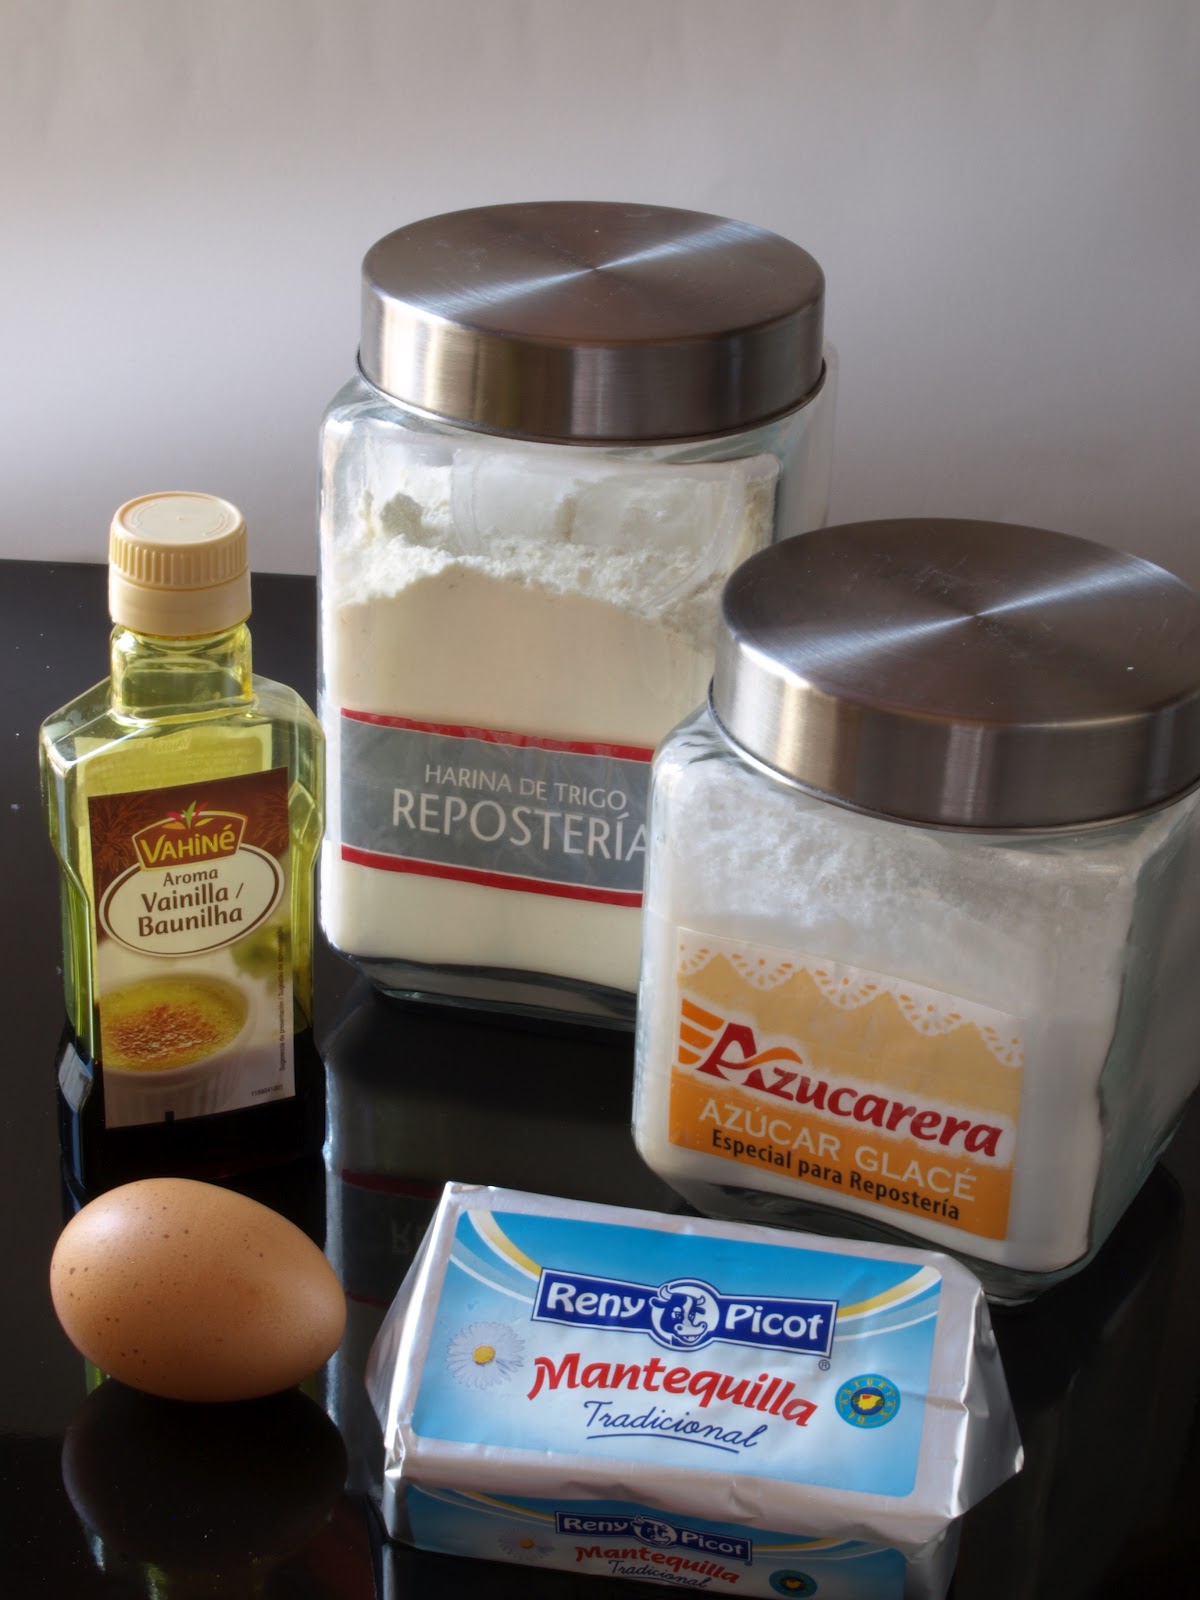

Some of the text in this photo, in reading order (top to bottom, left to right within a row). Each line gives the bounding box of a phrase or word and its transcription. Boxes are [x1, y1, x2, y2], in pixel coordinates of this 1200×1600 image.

[425, 764, 627, 811] HARINA DE TRIGO
[392, 788, 648, 862] REPOSTERÍA
[141, 882, 245, 913] Vainilla /
[163, 868, 219, 887] Aroma
[138, 904, 243, 937] Baunilha
[695, 1022, 1003, 1157] Azucarera
[700, 1099, 977, 1201] AZÚCAR GLACÉ
[712, 1129, 960, 1221] Especial para Repostería
[547, 1282, 825, 1340] Reny Picot
[527, 1352, 819, 1427] Mantequilla
[583, 1400, 768, 1448] Tradicional
[564, 1517, 744, 1555] Reny Picot
[575, 1545, 740, 1584] Mantequilla
[608, 1560, 712, 1588] Tradicional
